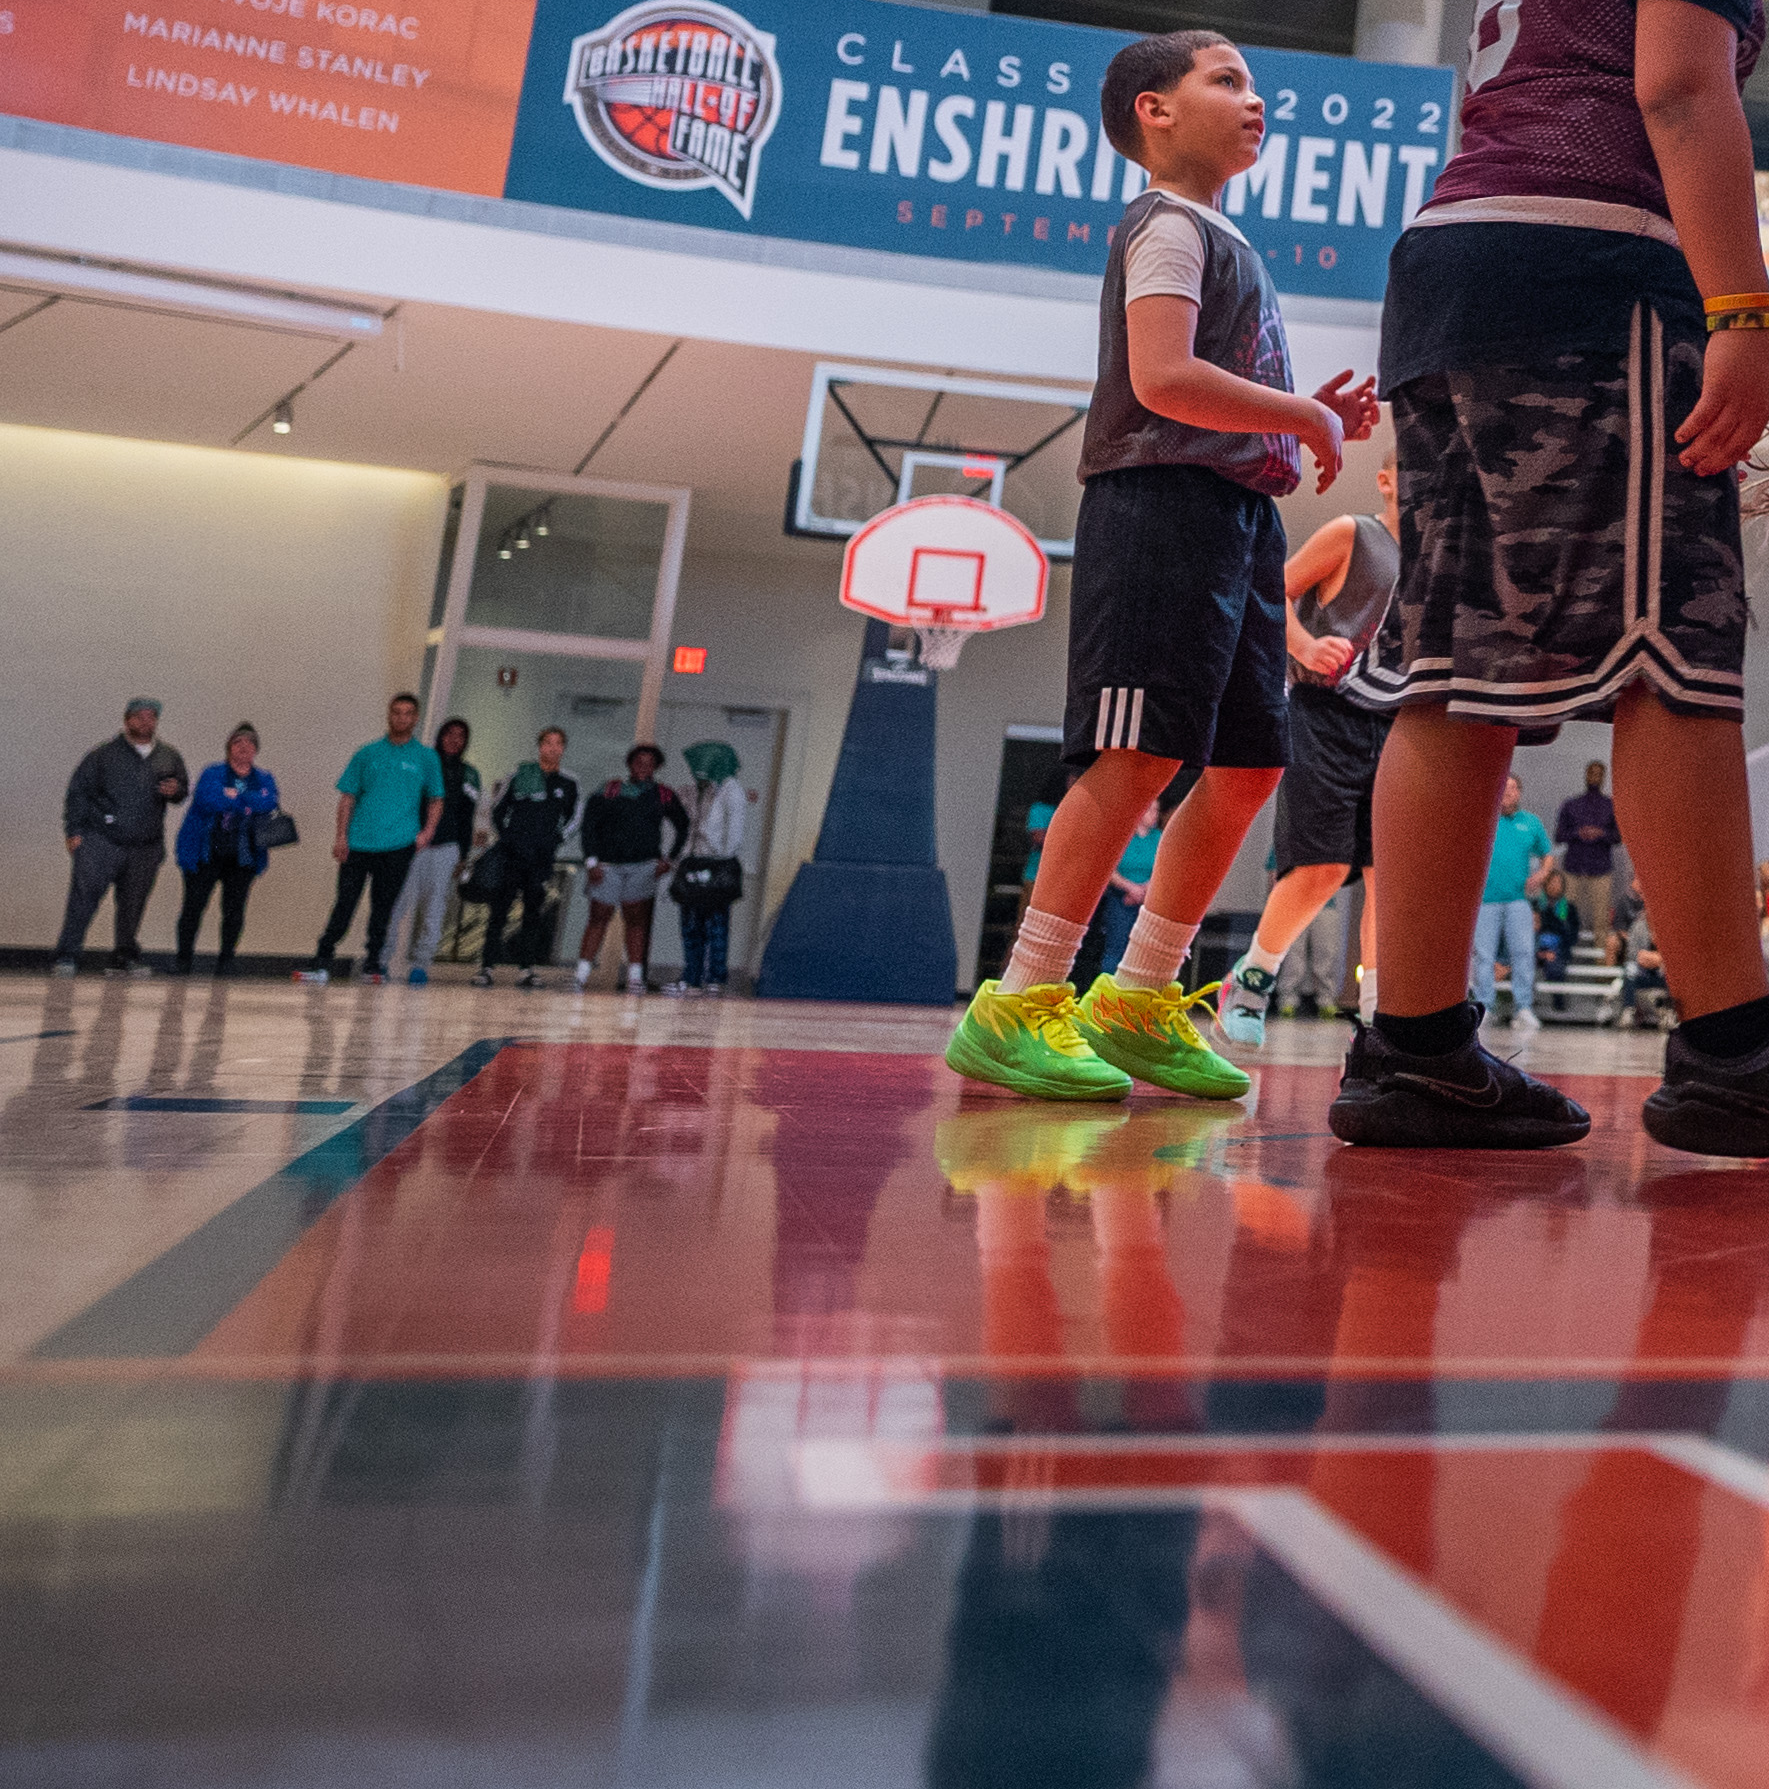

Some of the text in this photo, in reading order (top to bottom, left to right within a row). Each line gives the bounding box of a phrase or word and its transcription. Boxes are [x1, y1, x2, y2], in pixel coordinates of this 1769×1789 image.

[123, 11, 431, 89] MARIANNE STANLEY
[317, 0, 420, 40] KORAC
[588, 30, 758, 89] BASKETBALL
[836, 32, 1443, 134] CLASS 2022
[127, 63, 399, 134] LINDSAY WHALEN
[651, 78, 757, 130] HALL OF
[676, 116, 750, 188] FAME
[819, 76, 1439, 232] ENSHRIMENT
[896, 200, 1117, 247] SEPTEM
